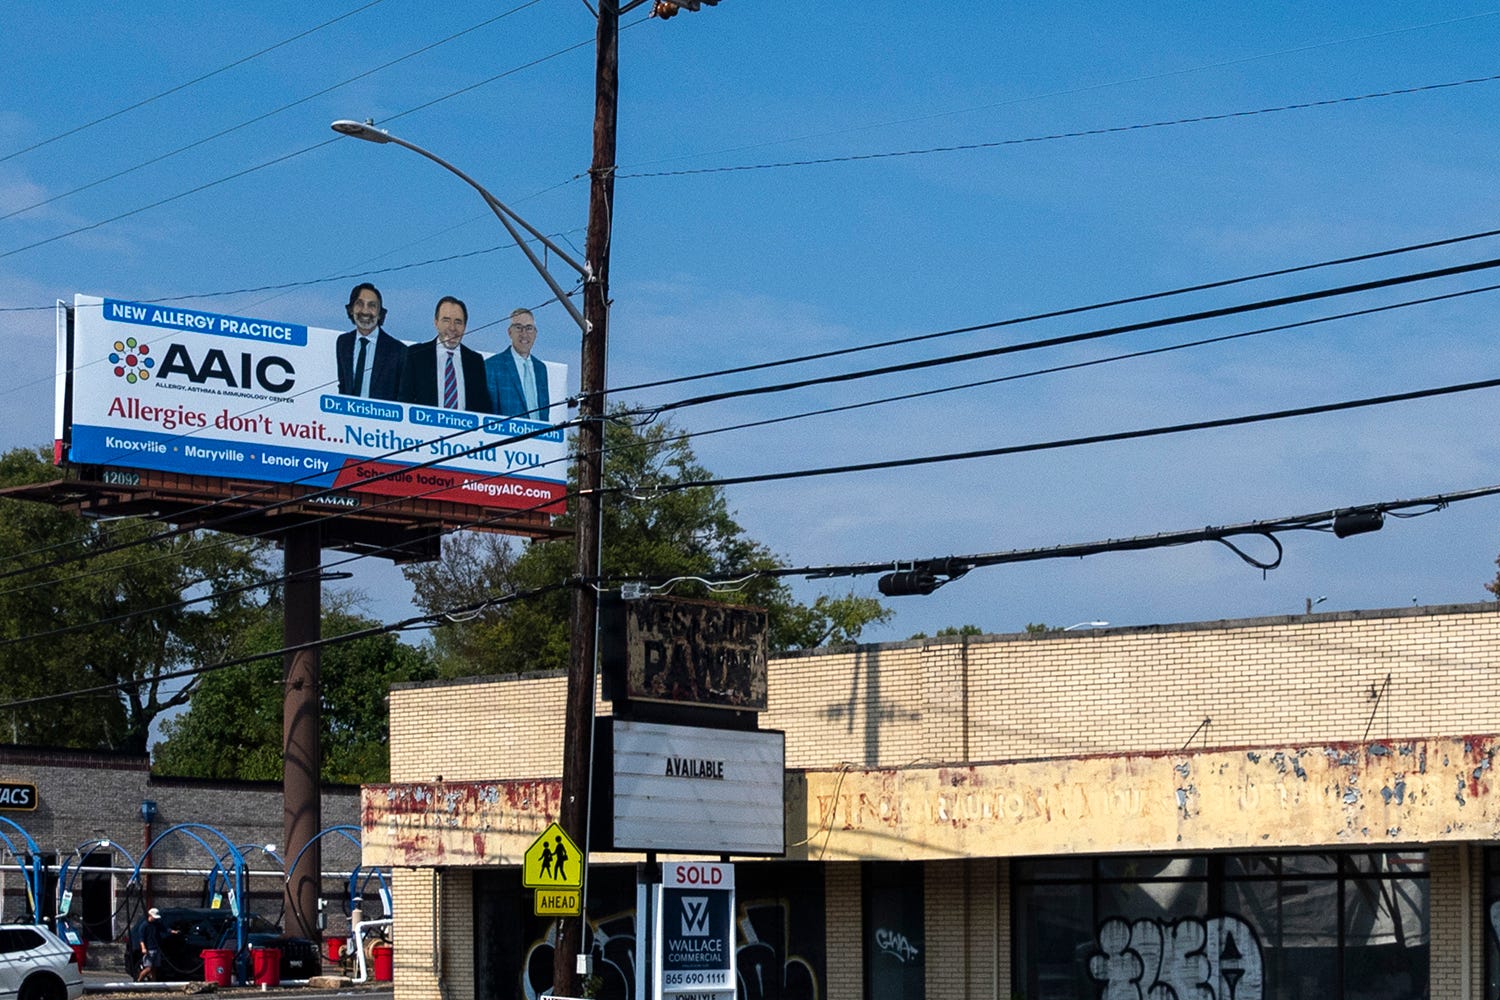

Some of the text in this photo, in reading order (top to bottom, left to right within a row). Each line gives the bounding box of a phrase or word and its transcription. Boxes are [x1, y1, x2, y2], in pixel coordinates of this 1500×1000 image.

[112, 303, 292, 341] NEW ALLERGY PRACTICE
[156, 343, 296, 394] AAIC
[188, 386, 216, 395] ASTHMA
[222, 390, 267, 401] IMMUNOLOGY
[324, 397, 400, 419] Dr. Krishnan
[108, 396, 207, 430] Allergies
[214, 409, 273, 435] don't
[345, 424, 424, 452] Neither
[416, 410, 473, 429] Dr. Prince
[105, 436, 329, 473] Knoxville Maryville Lenoir City
[103, 471, 140, 487] 12092
[417, 474, 454, 489] today!
[462, 478, 551, 500] AllergyAIC.com
[665, 757, 724, 779] AVAILABLE
[676, 866, 722, 885] SOLD
[541, 896, 575, 908] AHEAD
[668, 939, 722, 952] WALLACE
[668, 952, 722, 963] COMMERCIAL
[665, 973, 726, 985] 865 690 1111
